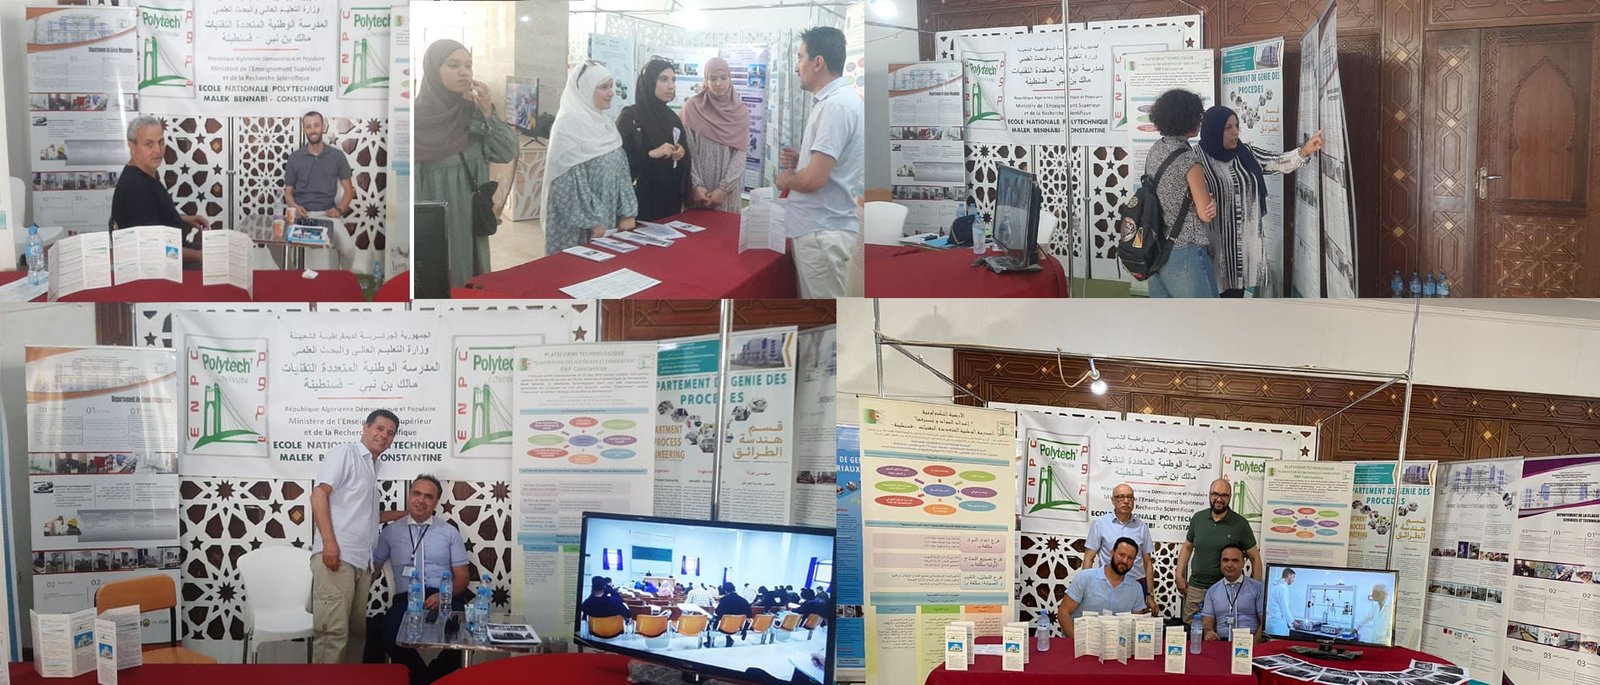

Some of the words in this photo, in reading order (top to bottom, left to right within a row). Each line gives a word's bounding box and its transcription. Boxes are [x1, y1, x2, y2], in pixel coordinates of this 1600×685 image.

[268, 20, 295, 30] الوطنية
[298, 19, 328, 30] المدرسة
[1223, 74, 1250, 85] DEPARTEMENT
[1258, 73, 1271, 81] GENIE
[1272, 71, 1280, 80] DES
[1238, 85, 1264, 94] PROCEDES
[377, 346, 405, 356] التعليم
[407, 346, 429, 355] وزارة
[281, 363, 317, 374] التقنيات
[321, 362, 358, 373] المتعددة
[363, 363, 398, 374] الوطنية
[402, 362, 440, 374] المدرسة
[304, 378, 343, 391] قسنطينة
[397, 379, 418, 389] مالك
[731, 374, 762, 387] GENIE
[766, 373, 787, 385] DES
[380, 380, 393, 391] بن
[680, 392, 744, 405] PROCEES
[748, 420, 783, 436] قسم
[739, 434, 783, 444] هندسة
[273, 441, 302, 449] ECOLE
[394, 441, 447, 449] TECHNIQUE
[280, 454, 313, 462] MALEK
[381, 454, 442, 462] ONSTANTINE
[732, 446, 782, 460] الطرائق
[1158, 460, 1182, 469] الوطنية
[1185, 462, 1212, 470] المدرسة
[1138, 497, 1178, 505] l'Enseignement
[1366, 497, 1405, 505] PROCEDS
[1577, 659, 1586, 667] 03
